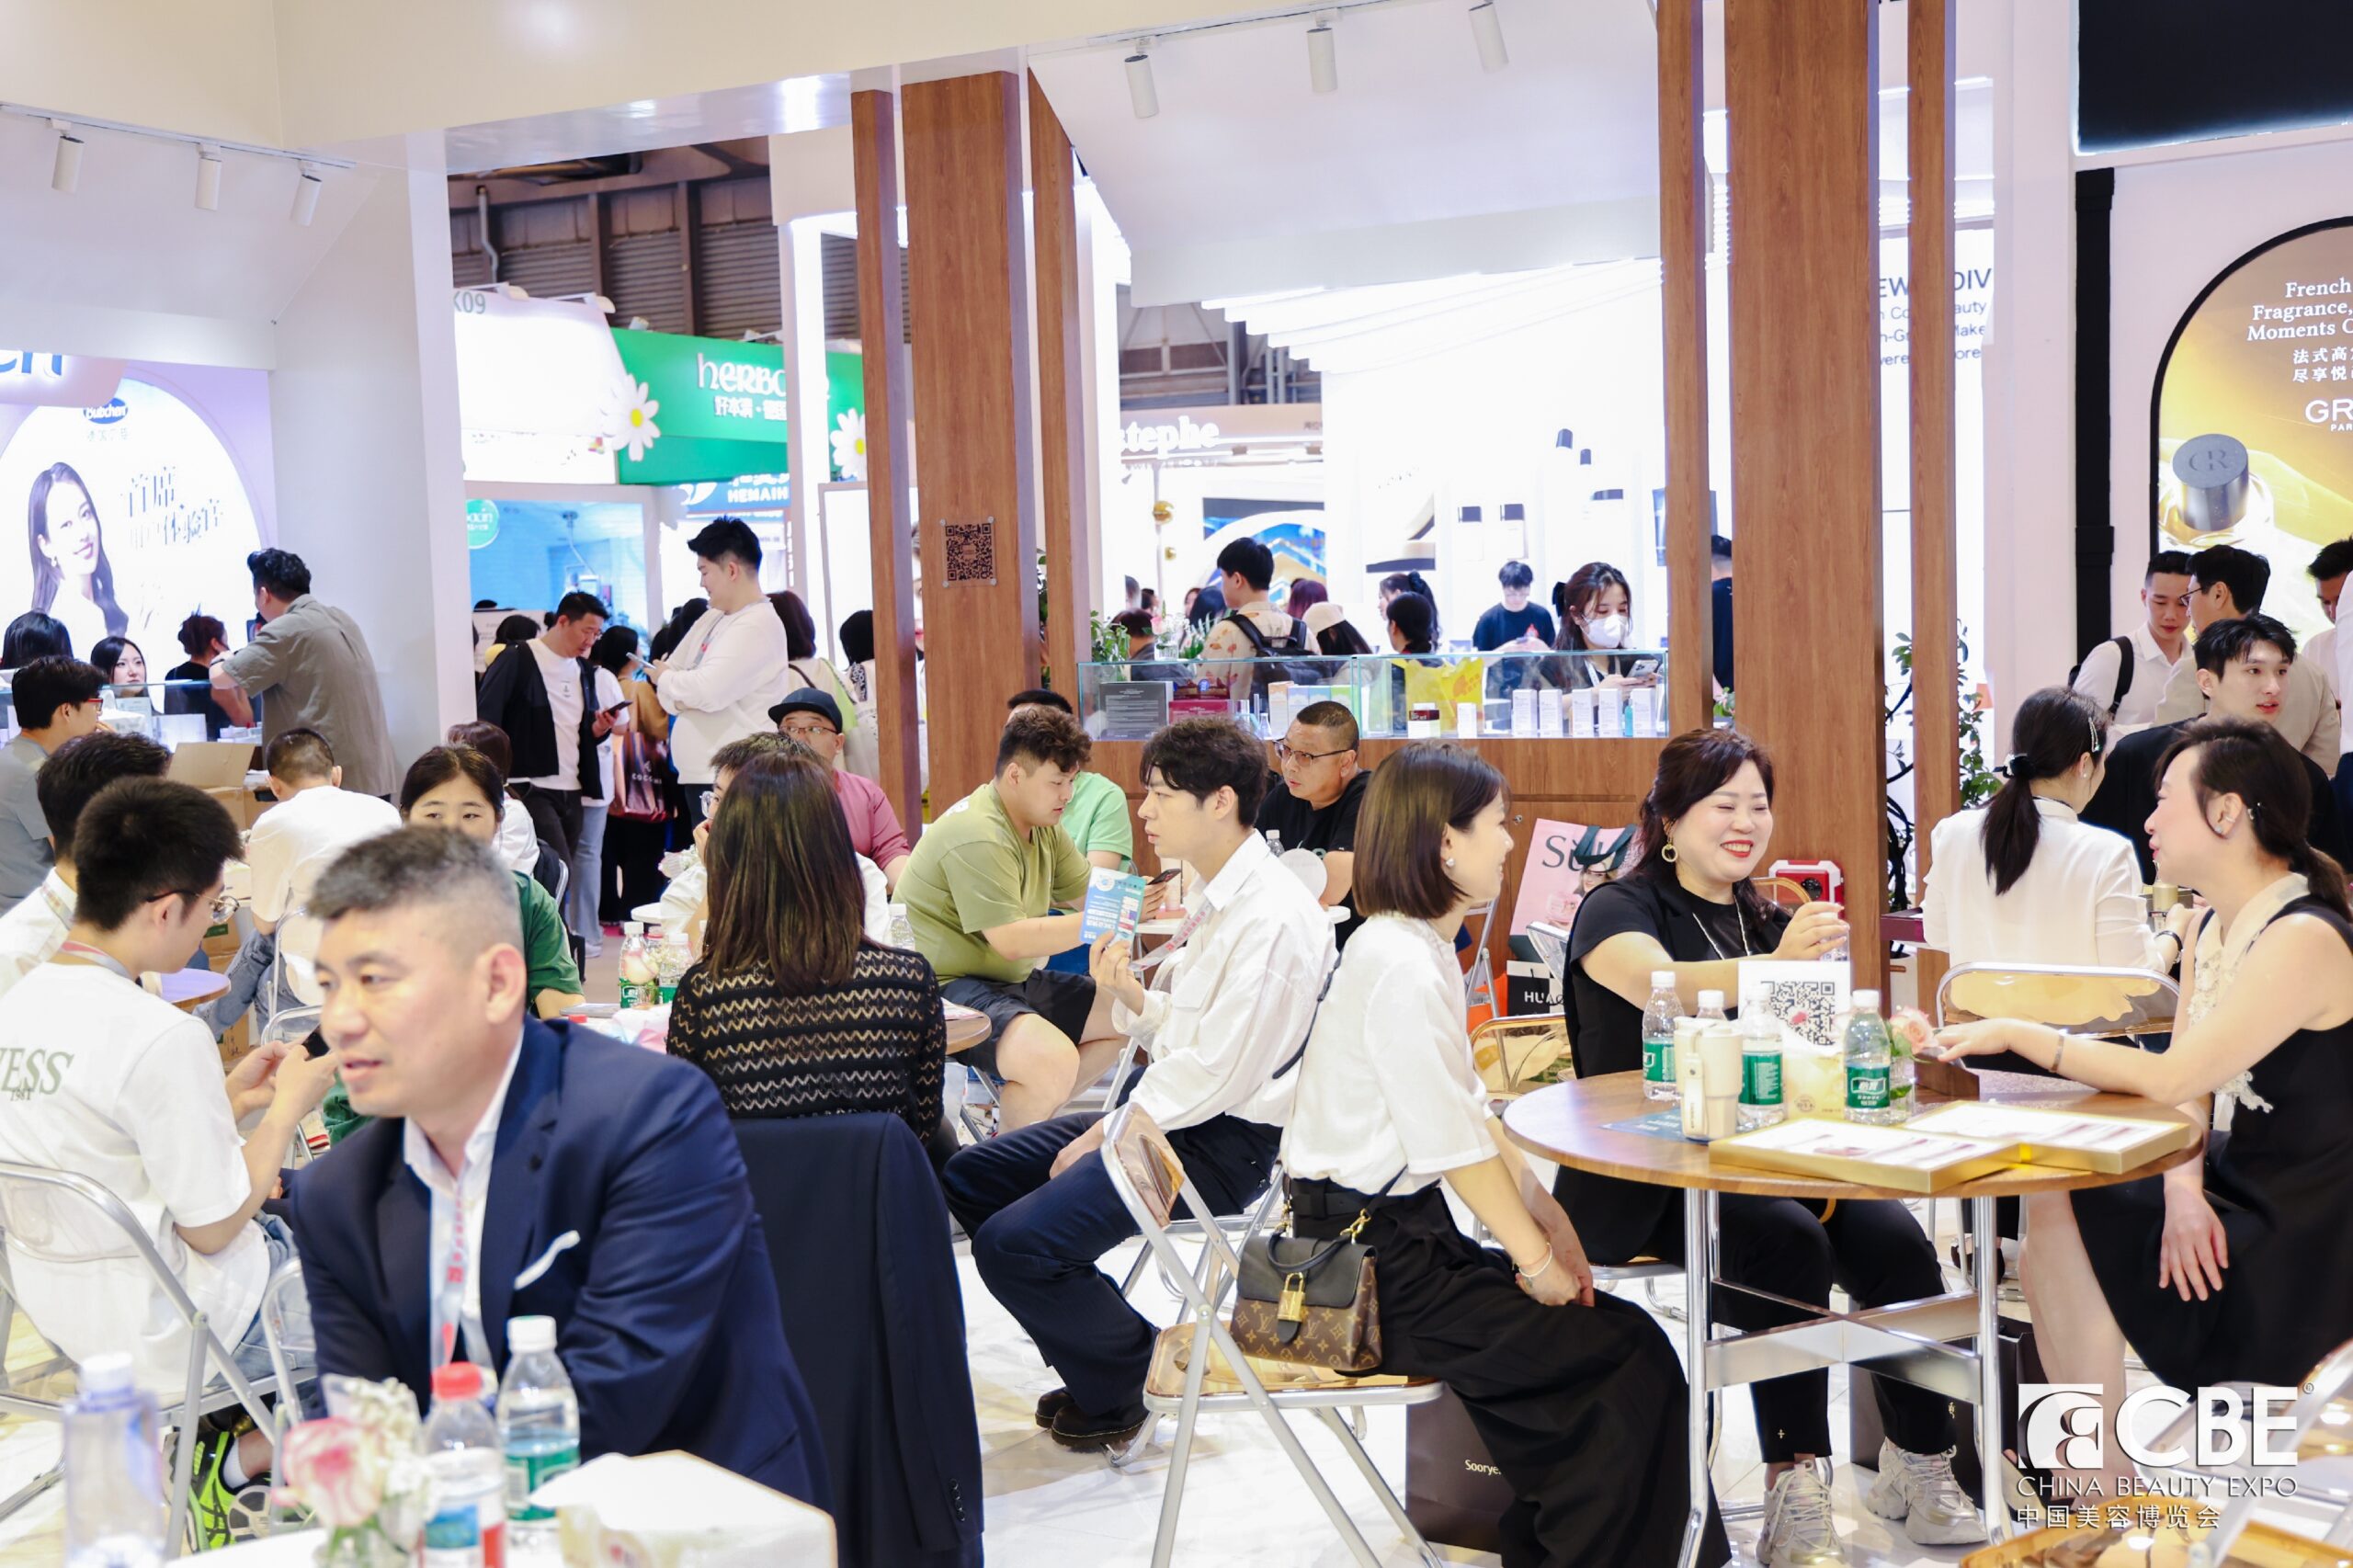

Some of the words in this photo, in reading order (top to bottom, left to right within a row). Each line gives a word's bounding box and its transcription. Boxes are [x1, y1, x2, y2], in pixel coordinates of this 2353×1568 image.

[2284, 276, 2352, 298] French
[2252, 301, 2353, 324] Fragrance,
[2246, 322, 2336, 342] Moments
[2292, 347, 2353, 365] 法式高
[2292, 366, 2353, 383] 尽享悦
